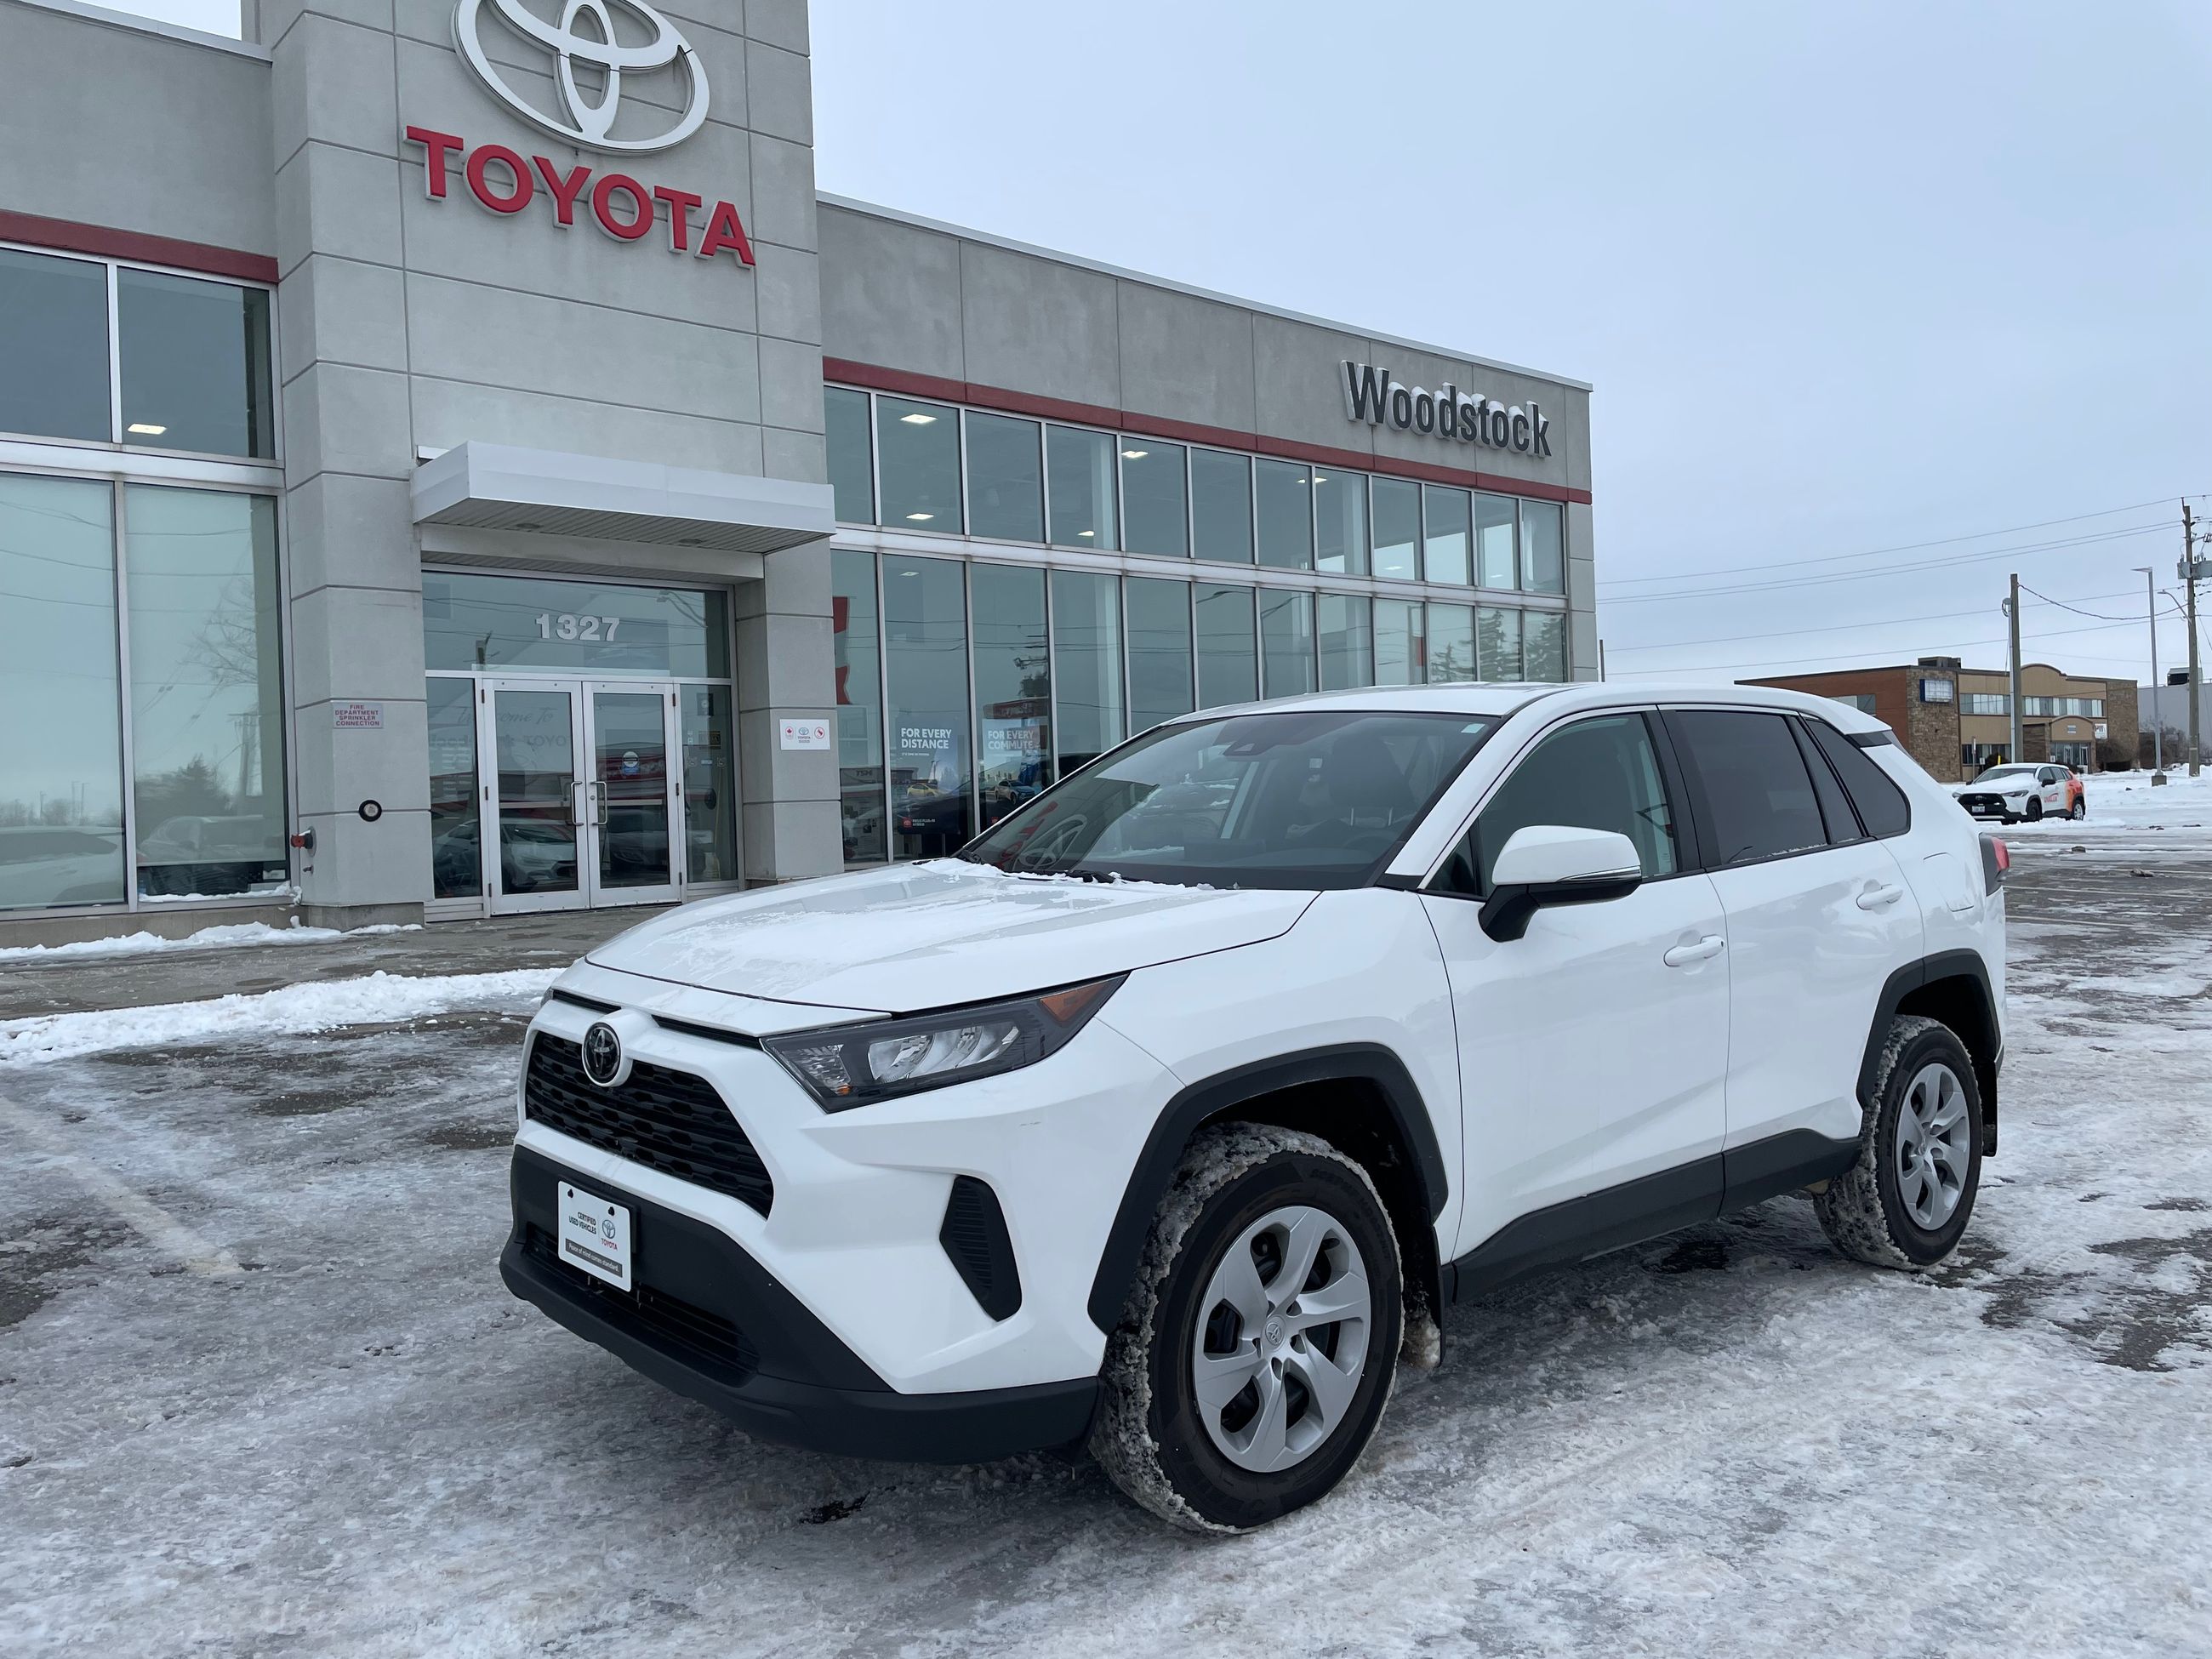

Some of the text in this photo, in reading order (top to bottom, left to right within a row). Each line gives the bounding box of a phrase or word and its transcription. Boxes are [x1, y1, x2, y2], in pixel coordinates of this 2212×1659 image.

[403, 125, 756, 269] TOYOTA
[1340, 360, 1552, 457] Woodstock
[535, 613, 620, 641] 1327
[901, 728, 951, 738] FOR EVERY
[988, 730, 1034, 740] FOR EVERY
[901, 738, 949, 750] DISTANCE
[988, 740, 1034, 750] COMMUTE
[568, 1216, 597, 1235] USED VEHICLES
[578, 1211, 596, 1226] CERTIFIED
[601, 1238, 618, 1251] TOYOTA
